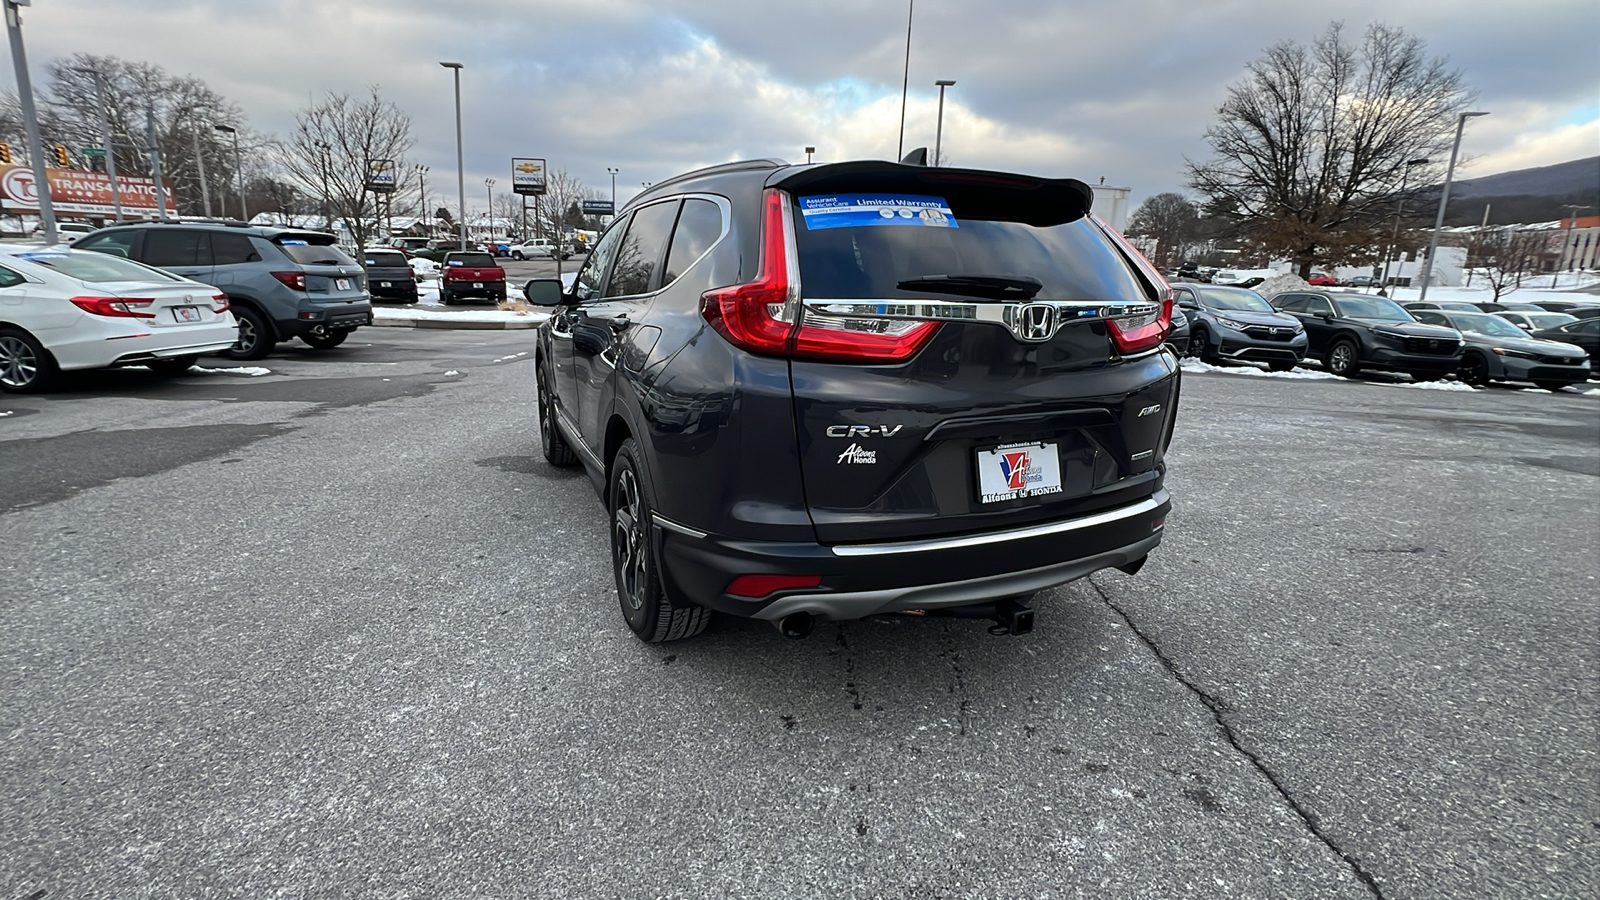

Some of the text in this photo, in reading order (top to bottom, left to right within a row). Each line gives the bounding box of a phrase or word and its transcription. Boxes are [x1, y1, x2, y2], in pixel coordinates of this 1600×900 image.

[896, 199, 942, 208] Warranty
[1138, 404, 1161, 417] AWD
[826, 424, 904, 438] CR-V
[837, 442, 876, 464] Altoona
[982, 485, 1063, 504] Altoona HONDA
